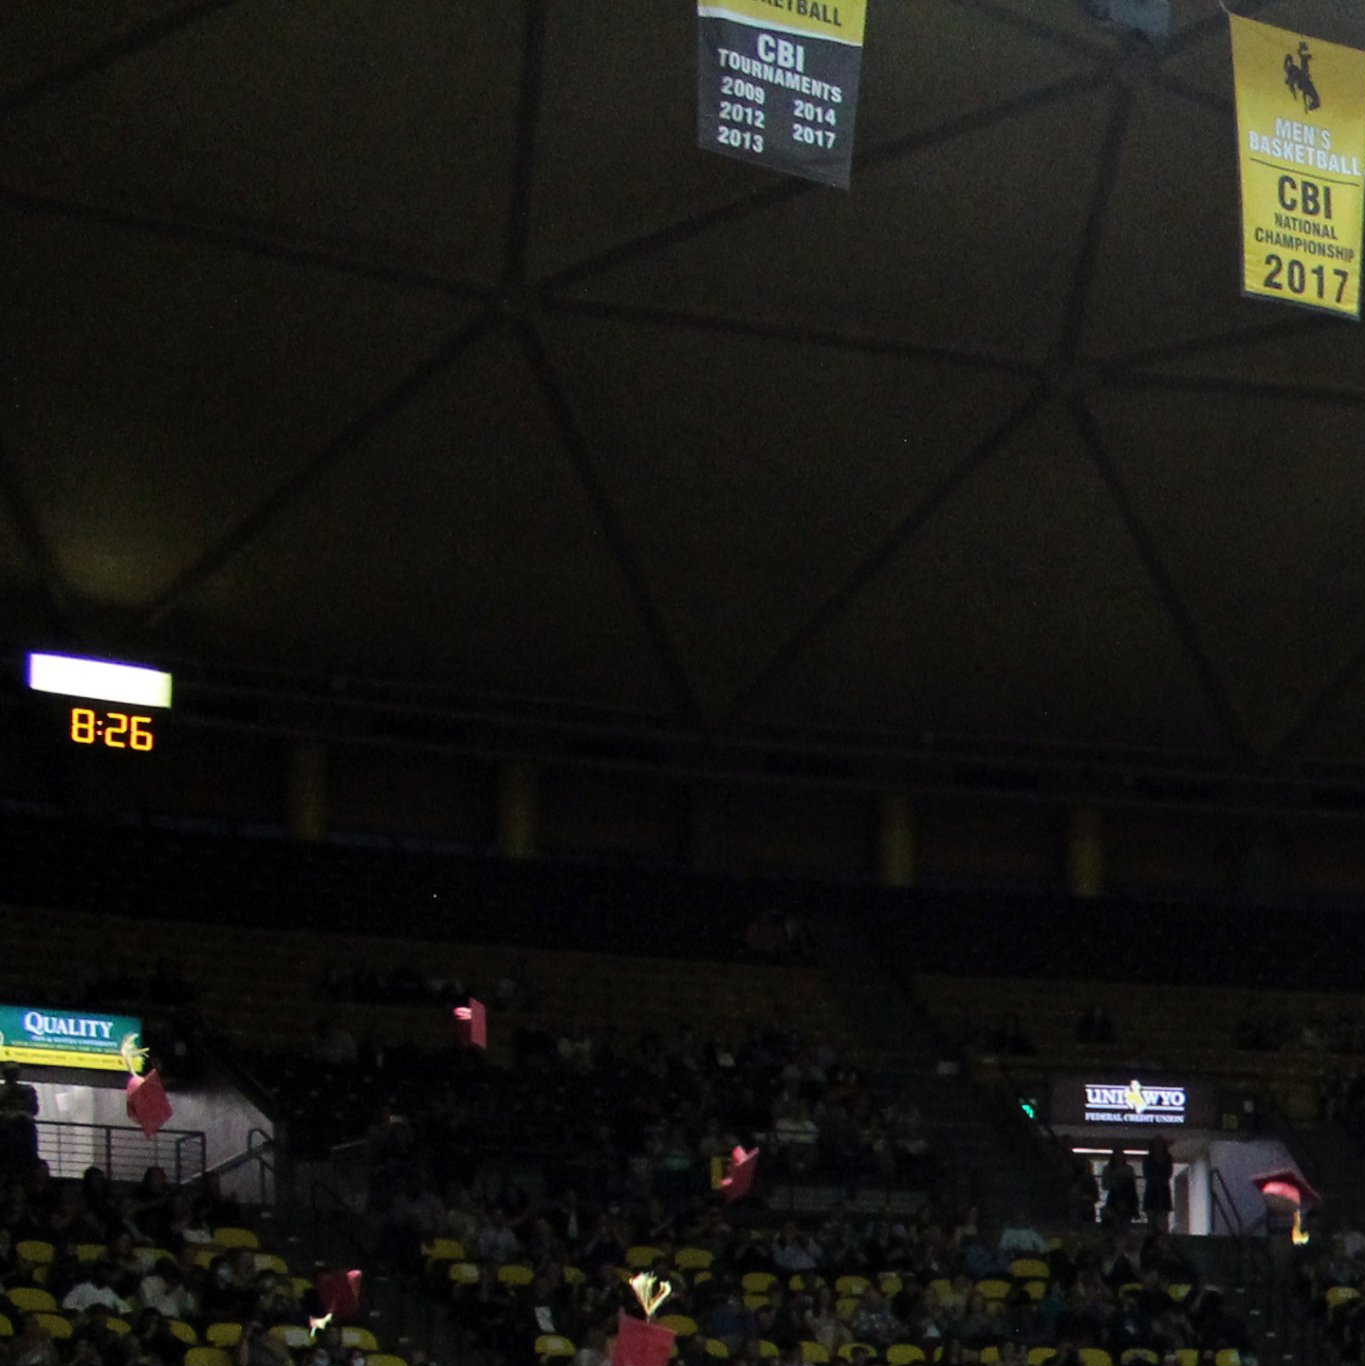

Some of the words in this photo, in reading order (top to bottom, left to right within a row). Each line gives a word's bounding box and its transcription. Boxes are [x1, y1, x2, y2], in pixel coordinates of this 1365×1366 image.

[757, 34, 805, 73] CBI
[718, 49, 842, 103] TOURNAMENTS
[721, 76, 765, 105] 2009
[793, 99, 837, 126] 2014
[717, 126, 764, 153] 2013
[719, 101, 765, 129] 2012
[792, 124, 836, 149] 2017
[1275, 118, 1331, 149] MEN'S
[1249, 131, 1361, 176] BASKETBALL
[1278, 175, 1332, 219] CBI
[1255, 227, 1354, 263] CHAMPIONSHIP
[1275, 213, 1337, 240] NATIONAL
[1264, 254, 1349, 303] 2017
[71, 707, 154, 751] 8:26
[25, 1012, 113, 1038] QUALITY
[1085, 1112, 1123, 1122] FEDERAL
[1123, 1113, 1154, 1122] CREDIT
[1155, 1115, 1184, 1123] UNION
